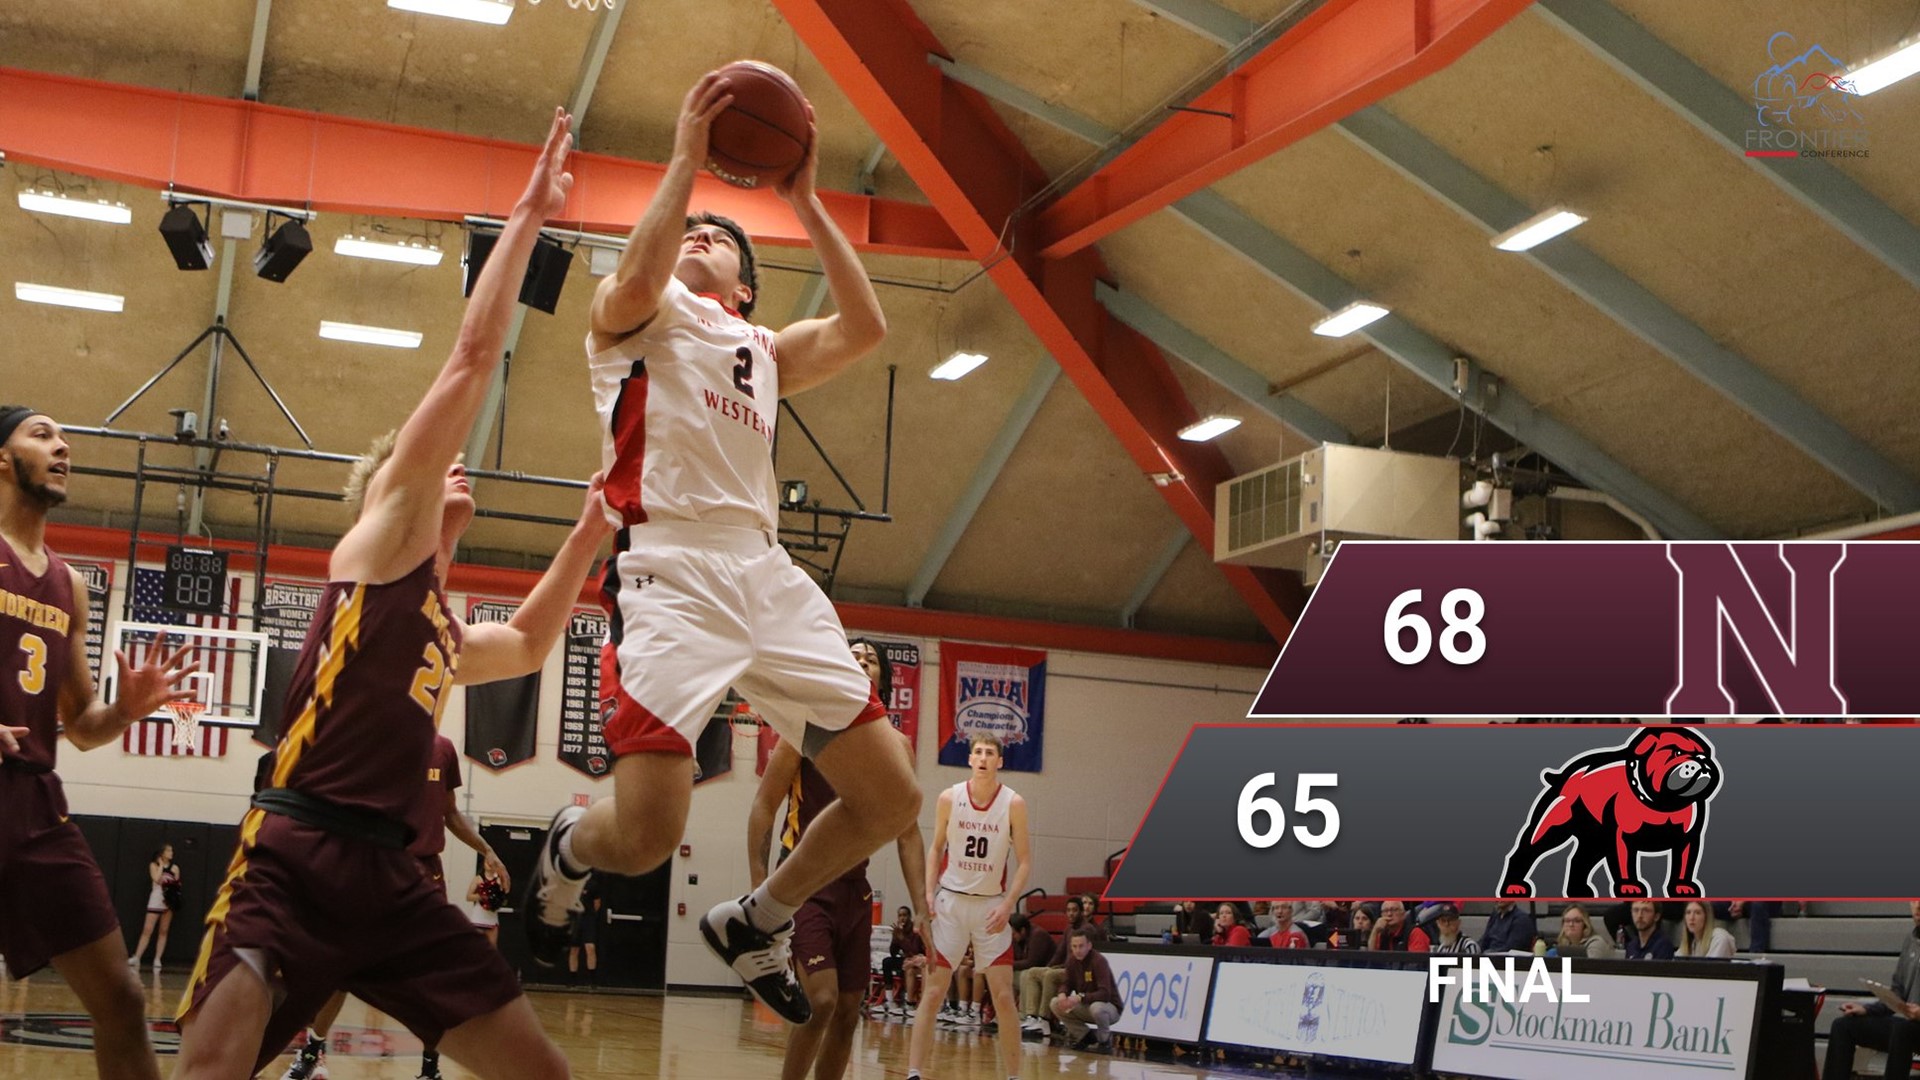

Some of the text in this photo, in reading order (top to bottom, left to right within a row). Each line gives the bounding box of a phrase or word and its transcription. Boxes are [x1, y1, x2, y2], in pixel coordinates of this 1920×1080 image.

[733, 346, 755, 400] 2
[19, 633, 47, 694] 3
[960, 677, 1024, 709] NAIA
[963, 719, 1018, 731] of Character
[967, 709, 1015, 721] Champions
[958, 821, 1000, 834] MONTANA
[965, 835, 988, 858] 20
[958, 861, 994, 873] WESTERN
[1643, 991, 1735, 1055] Bank
